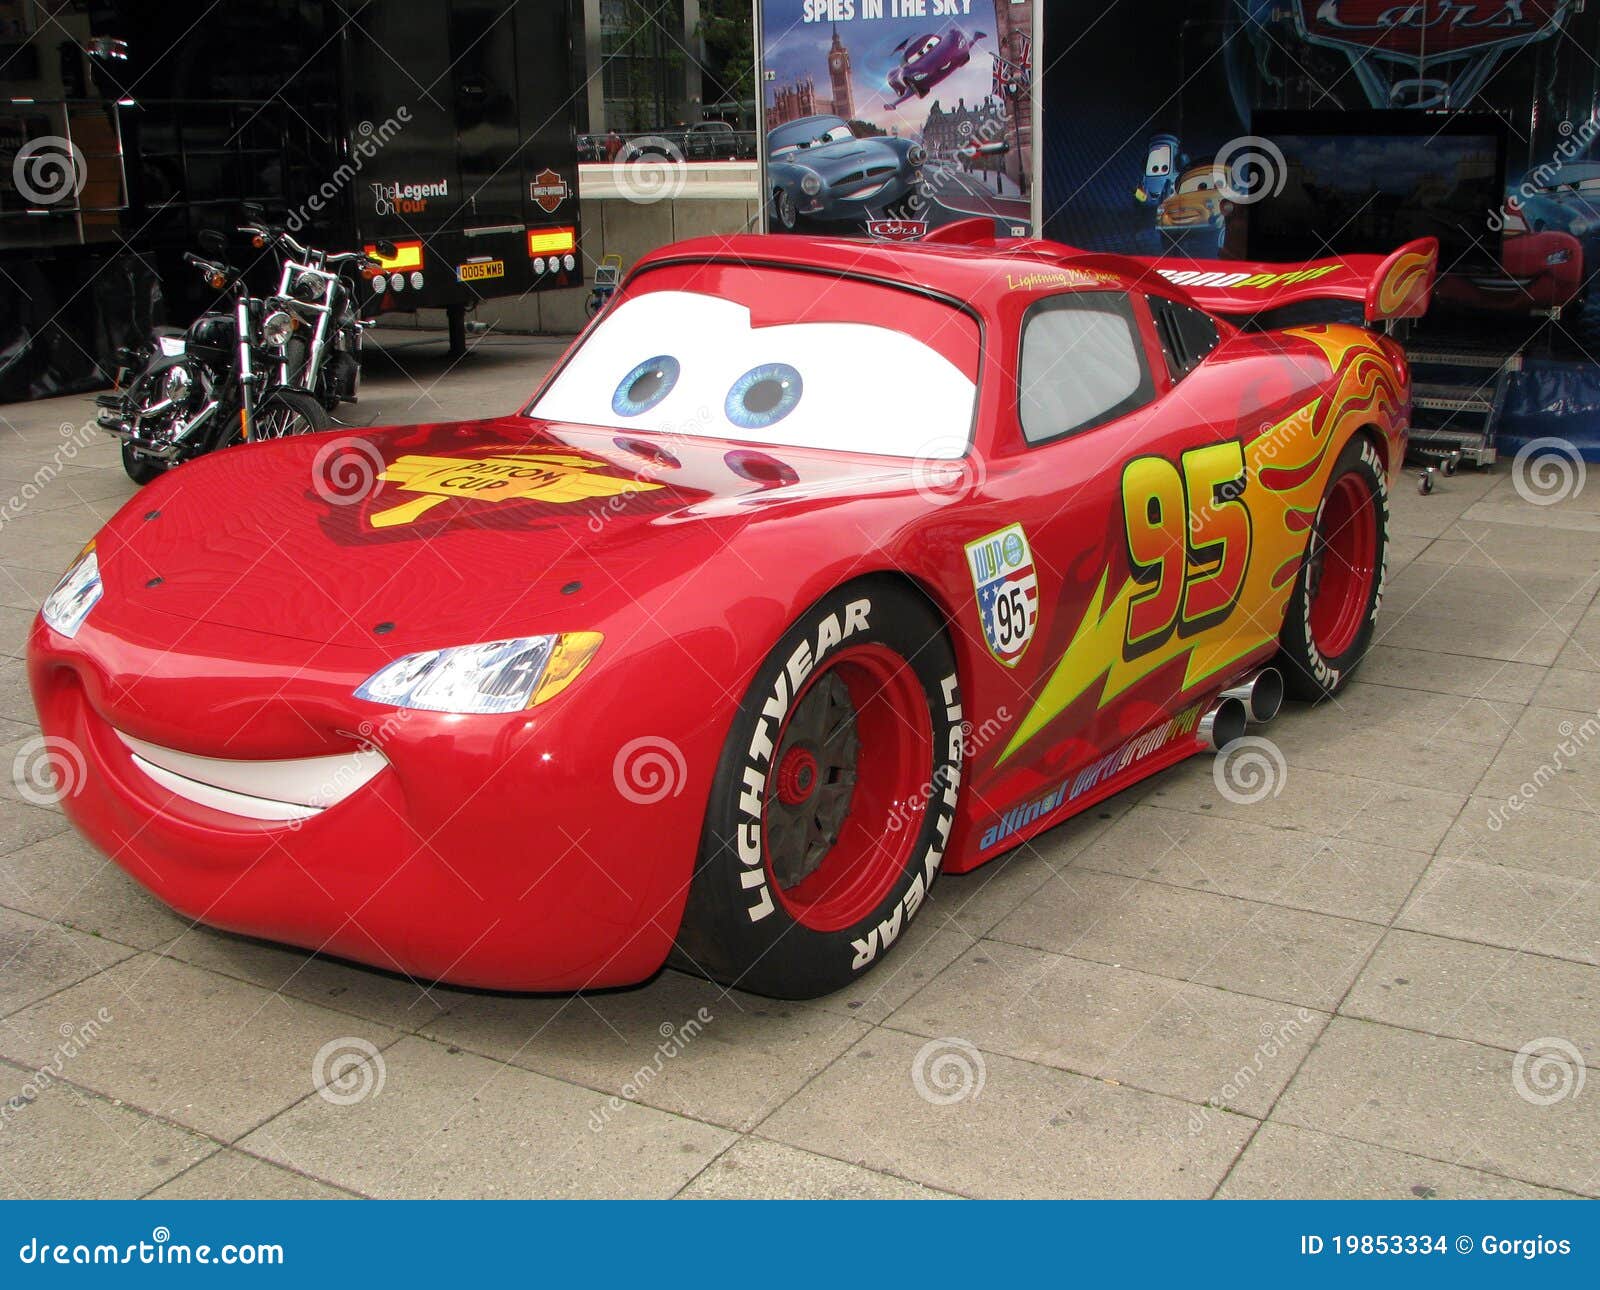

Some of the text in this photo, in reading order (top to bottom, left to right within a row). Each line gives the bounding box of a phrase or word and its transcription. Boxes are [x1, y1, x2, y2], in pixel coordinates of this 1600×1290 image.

[803, 0, 972, 23] SPIES IN THE SKY
[439, 476, 509, 492] CUP
[462, 462, 568, 483] PISTON
[1122, 436, 1252, 662] 95
[997, 587, 1026, 647] 95
[737, 598, 871, 923] LIGHTYEAR
[851, 672, 963, 971] LIGHTYEAR
[979, 780, 1069, 850] allinol
